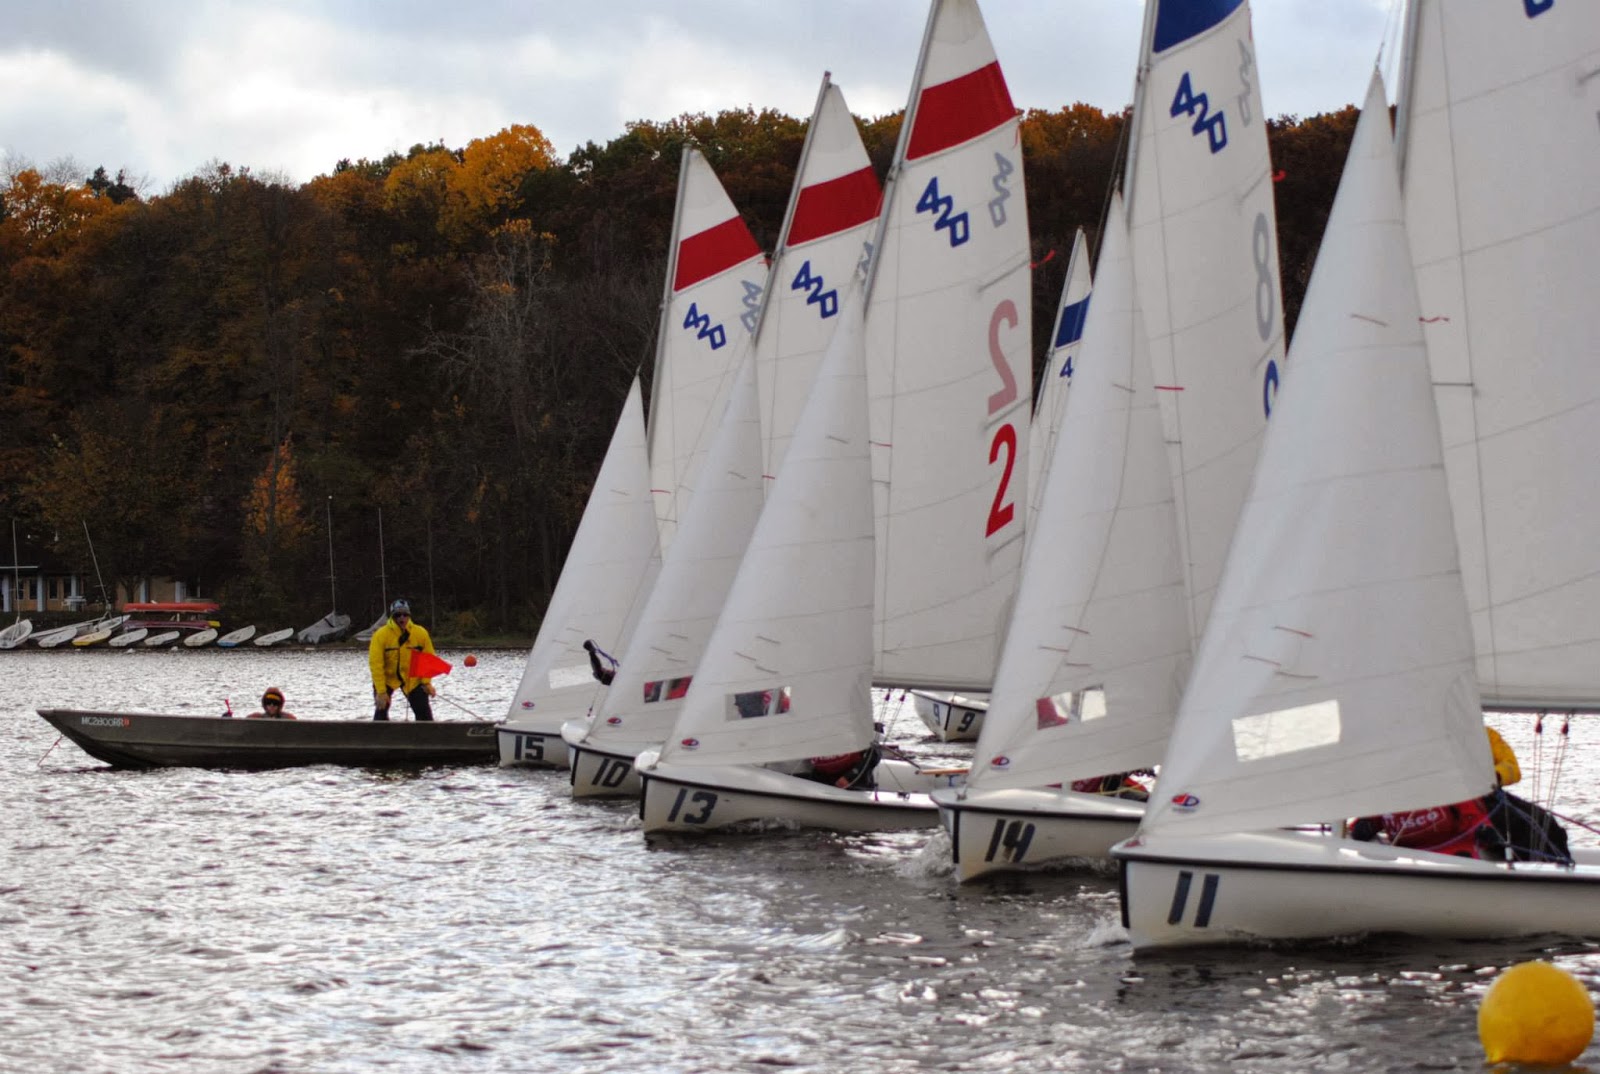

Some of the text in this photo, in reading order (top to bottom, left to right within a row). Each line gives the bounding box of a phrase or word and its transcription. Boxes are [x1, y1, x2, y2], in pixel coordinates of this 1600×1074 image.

[1170, 71, 1228, 154] 420
[916, 176, 970, 248] 420
[791, 260, 838, 319] 420
[683, 302, 726, 350] 420
[985, 423, 1017, 539] 2
[957, 711, 976, 733] 9
[514, 735, 545, 761] 15
[592, 758, 631, 788] 10
[667, 788, 718, 825] 13
[984, 818, 1036, 864] 14
[1167, 870, 1220, 928] 11
